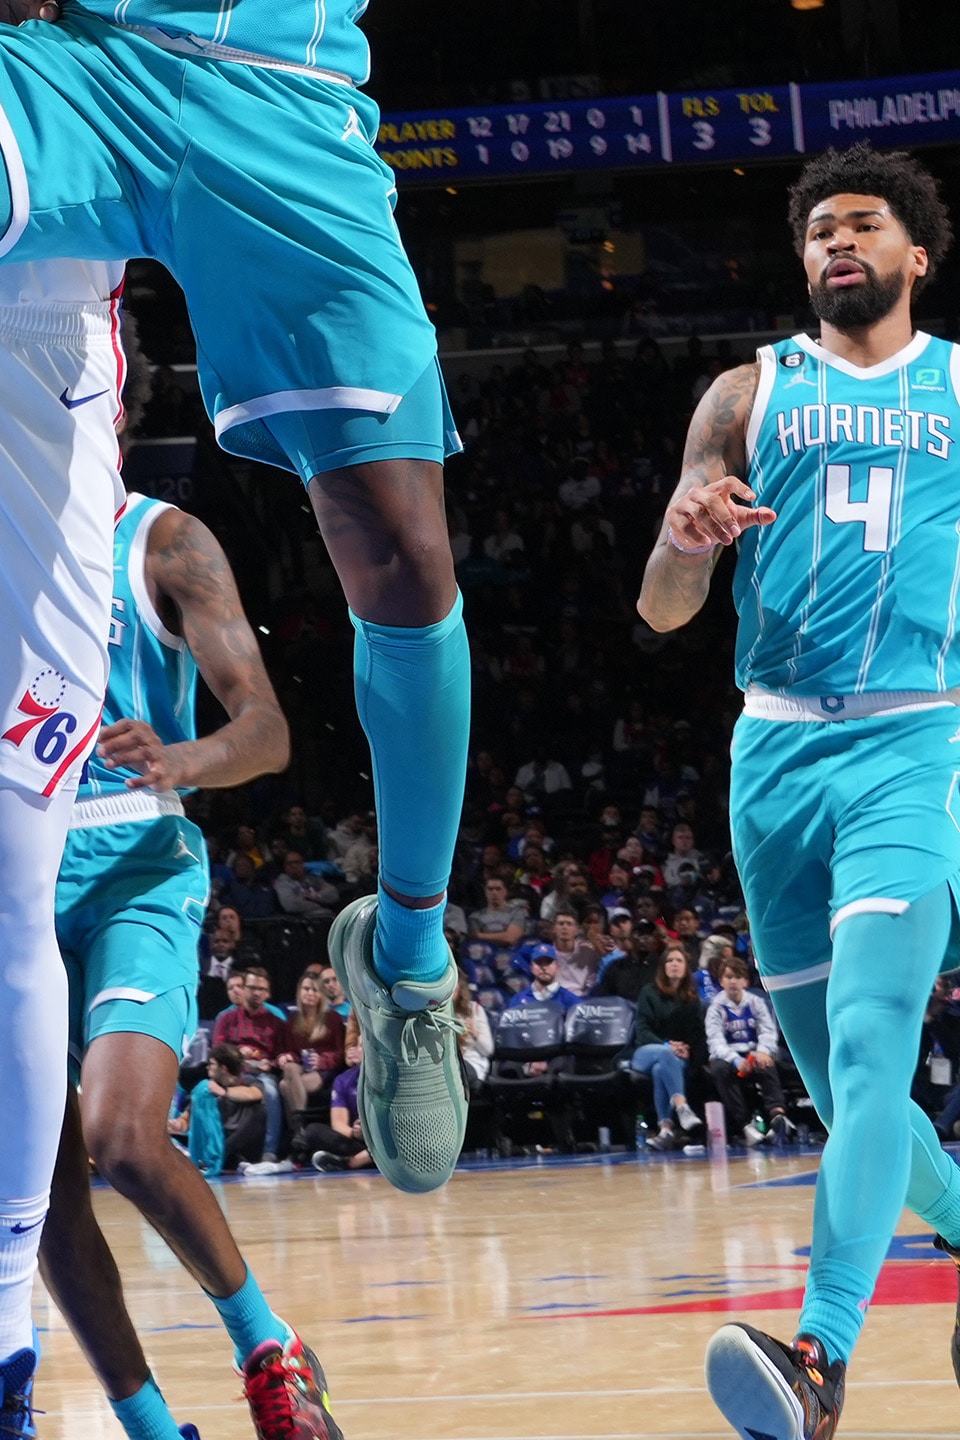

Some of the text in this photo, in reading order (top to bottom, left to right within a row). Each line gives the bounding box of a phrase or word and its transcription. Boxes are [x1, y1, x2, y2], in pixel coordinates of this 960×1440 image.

[378, 119, 456, 144] PLAYER
[630, 105, 643, 127] 1
[692, 117, 771, 150] 3 3
[475, 143, 489, 164] 1
[775, 403, 955, 461] HORNETS
[824, 463, 895, 553] 4
[1, 689, 77, 765] 76
